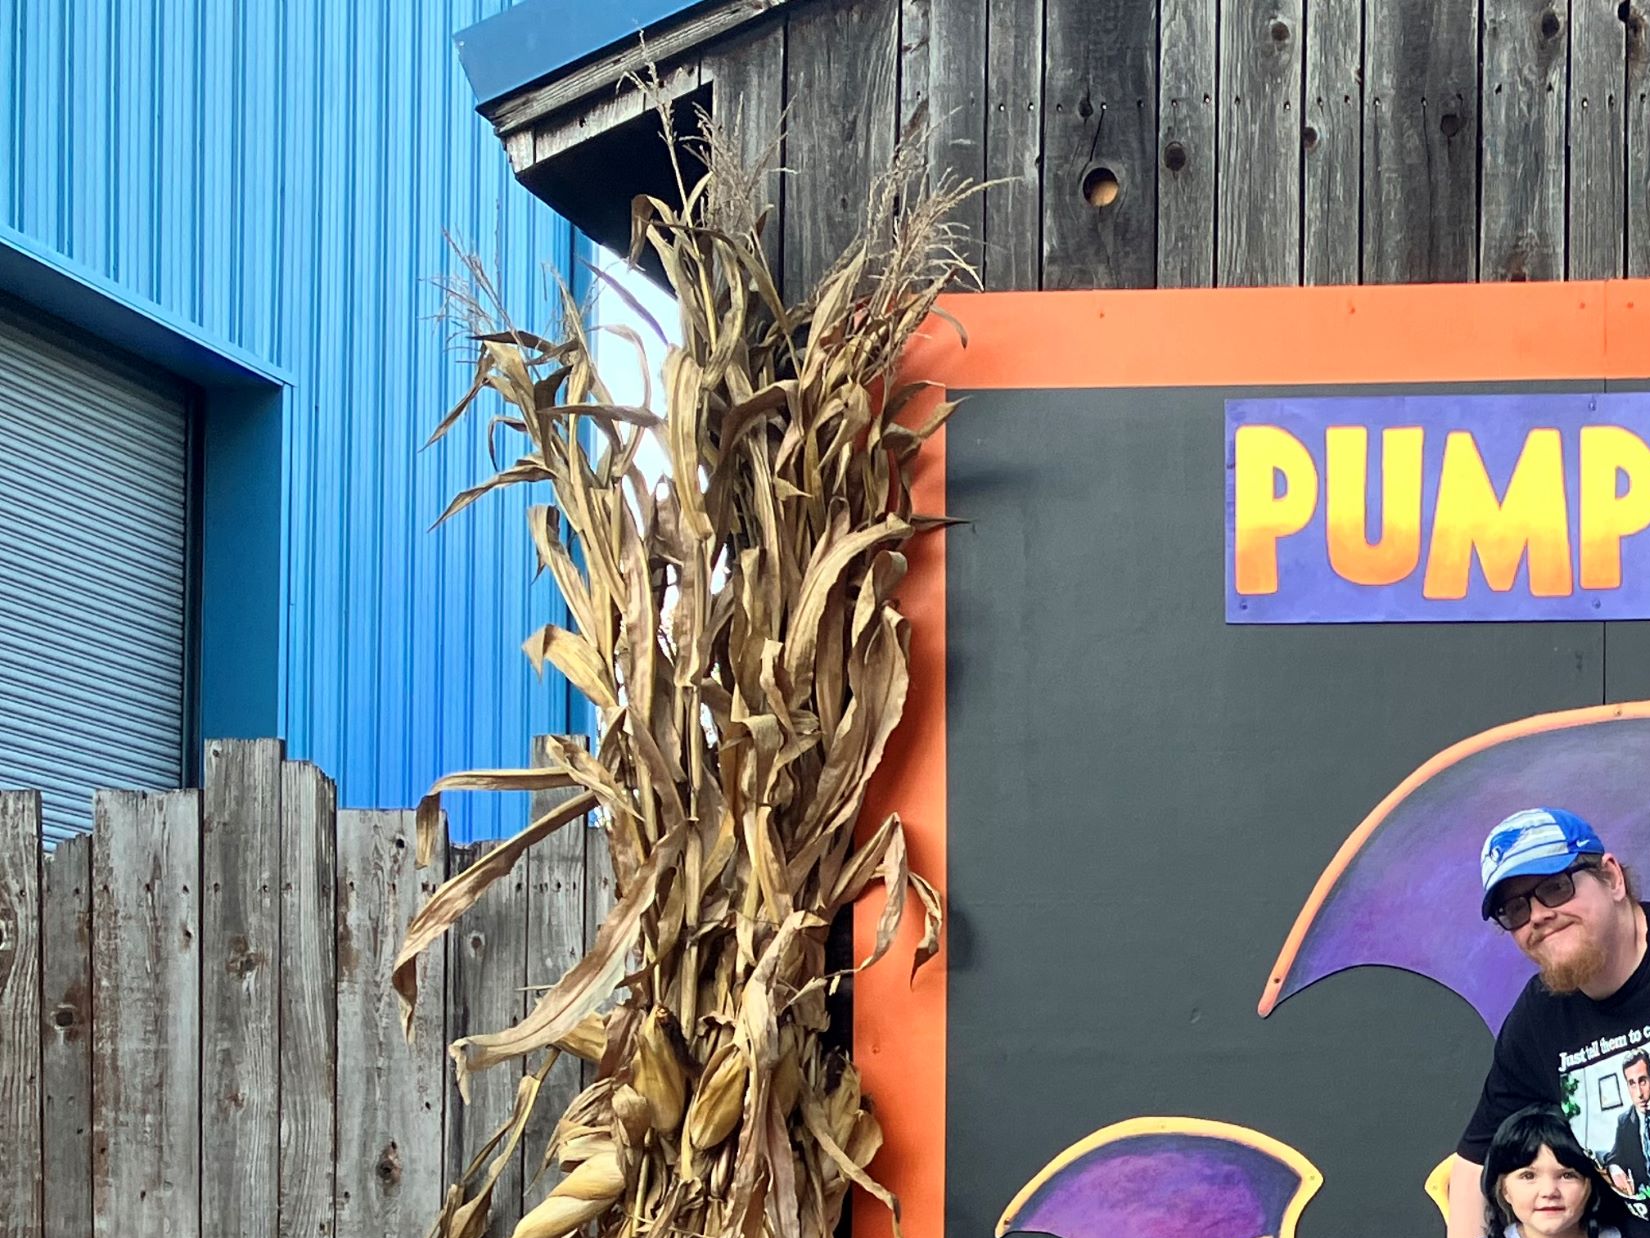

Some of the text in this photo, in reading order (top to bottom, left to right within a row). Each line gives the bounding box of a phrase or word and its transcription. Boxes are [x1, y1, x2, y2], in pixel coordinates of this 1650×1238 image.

[1558, 1047, 1587, 1072] Just
[1600, 1036, 1627, 1054] them
[1628, 1029, 1642, 1043] to
